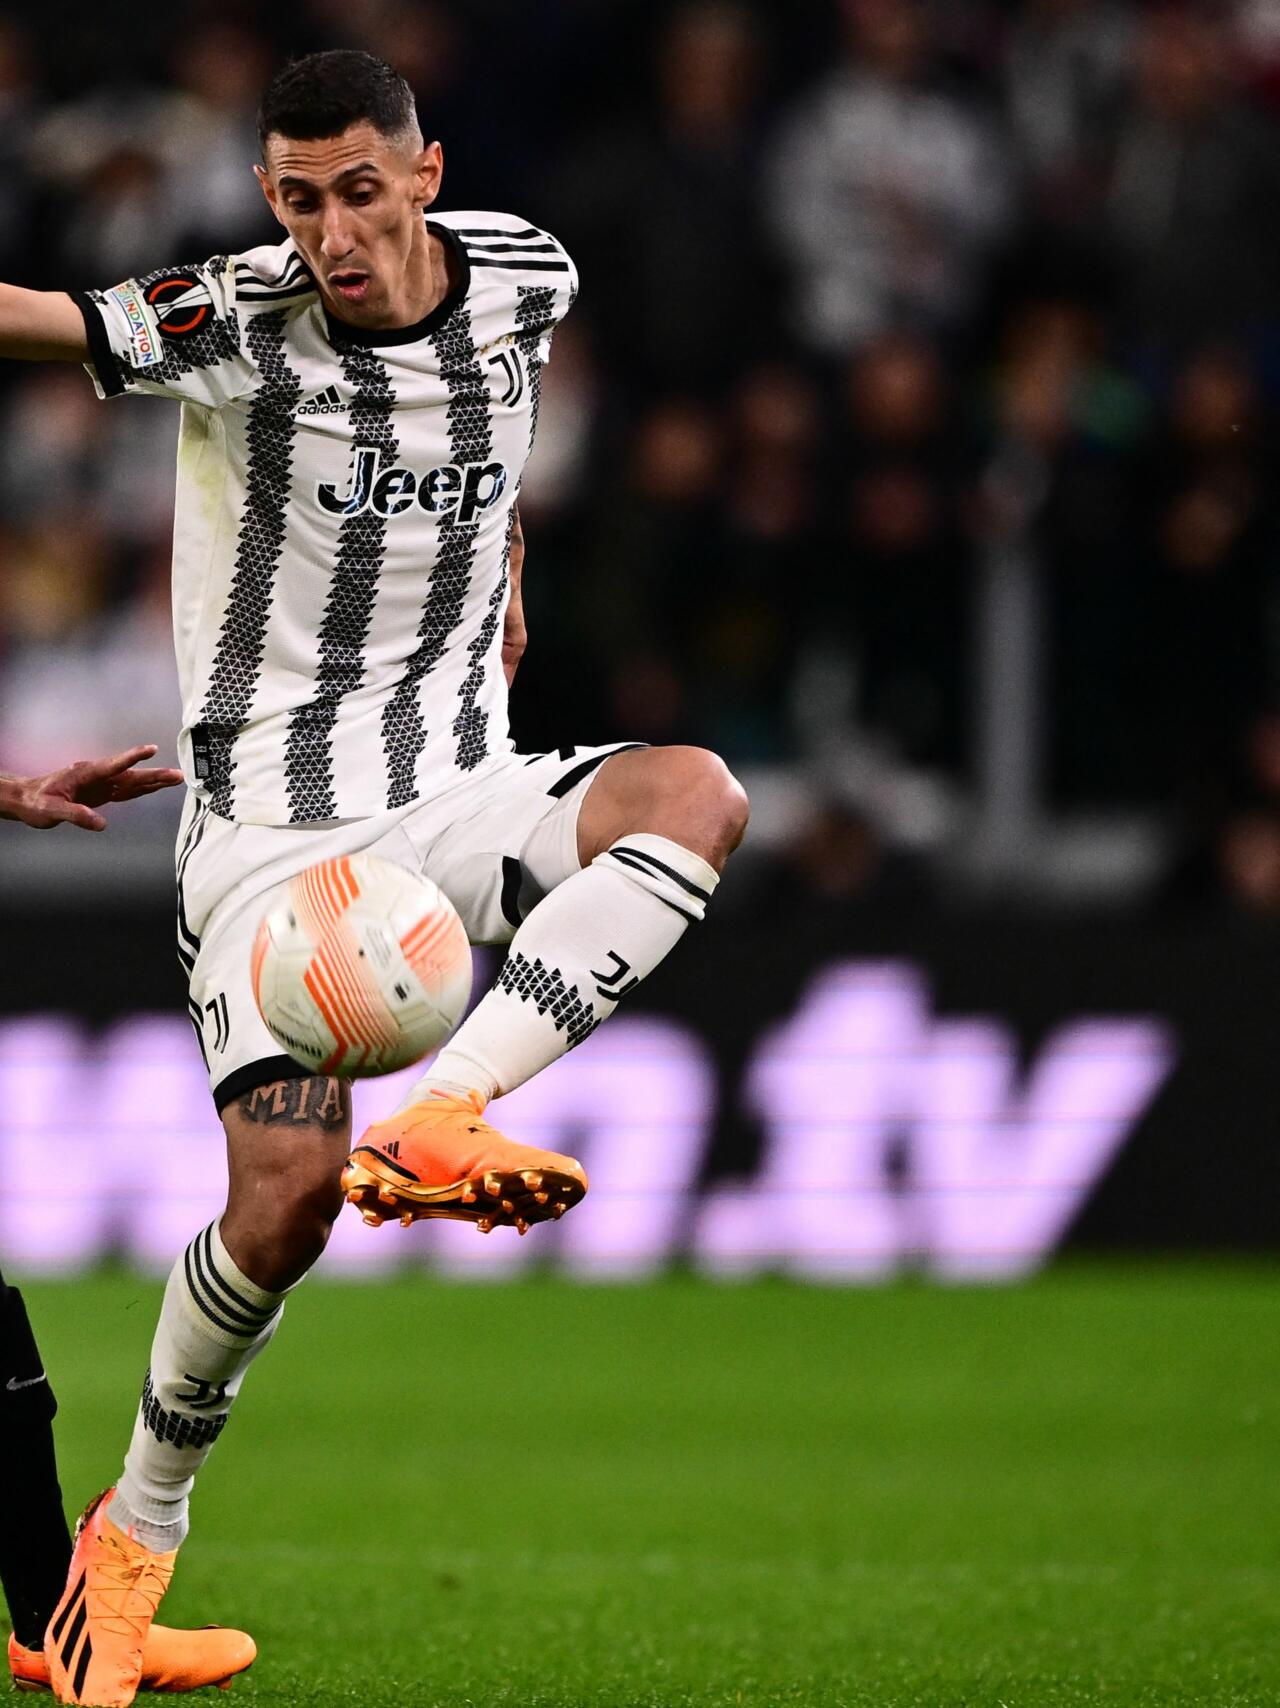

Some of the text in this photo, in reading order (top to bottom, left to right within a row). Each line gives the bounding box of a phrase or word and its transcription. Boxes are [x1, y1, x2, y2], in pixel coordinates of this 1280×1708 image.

[297, 401, 346, 415] adidas
[315, 447, 507, 525] Jeep
[249, 1078, 343, 1121] MIA
